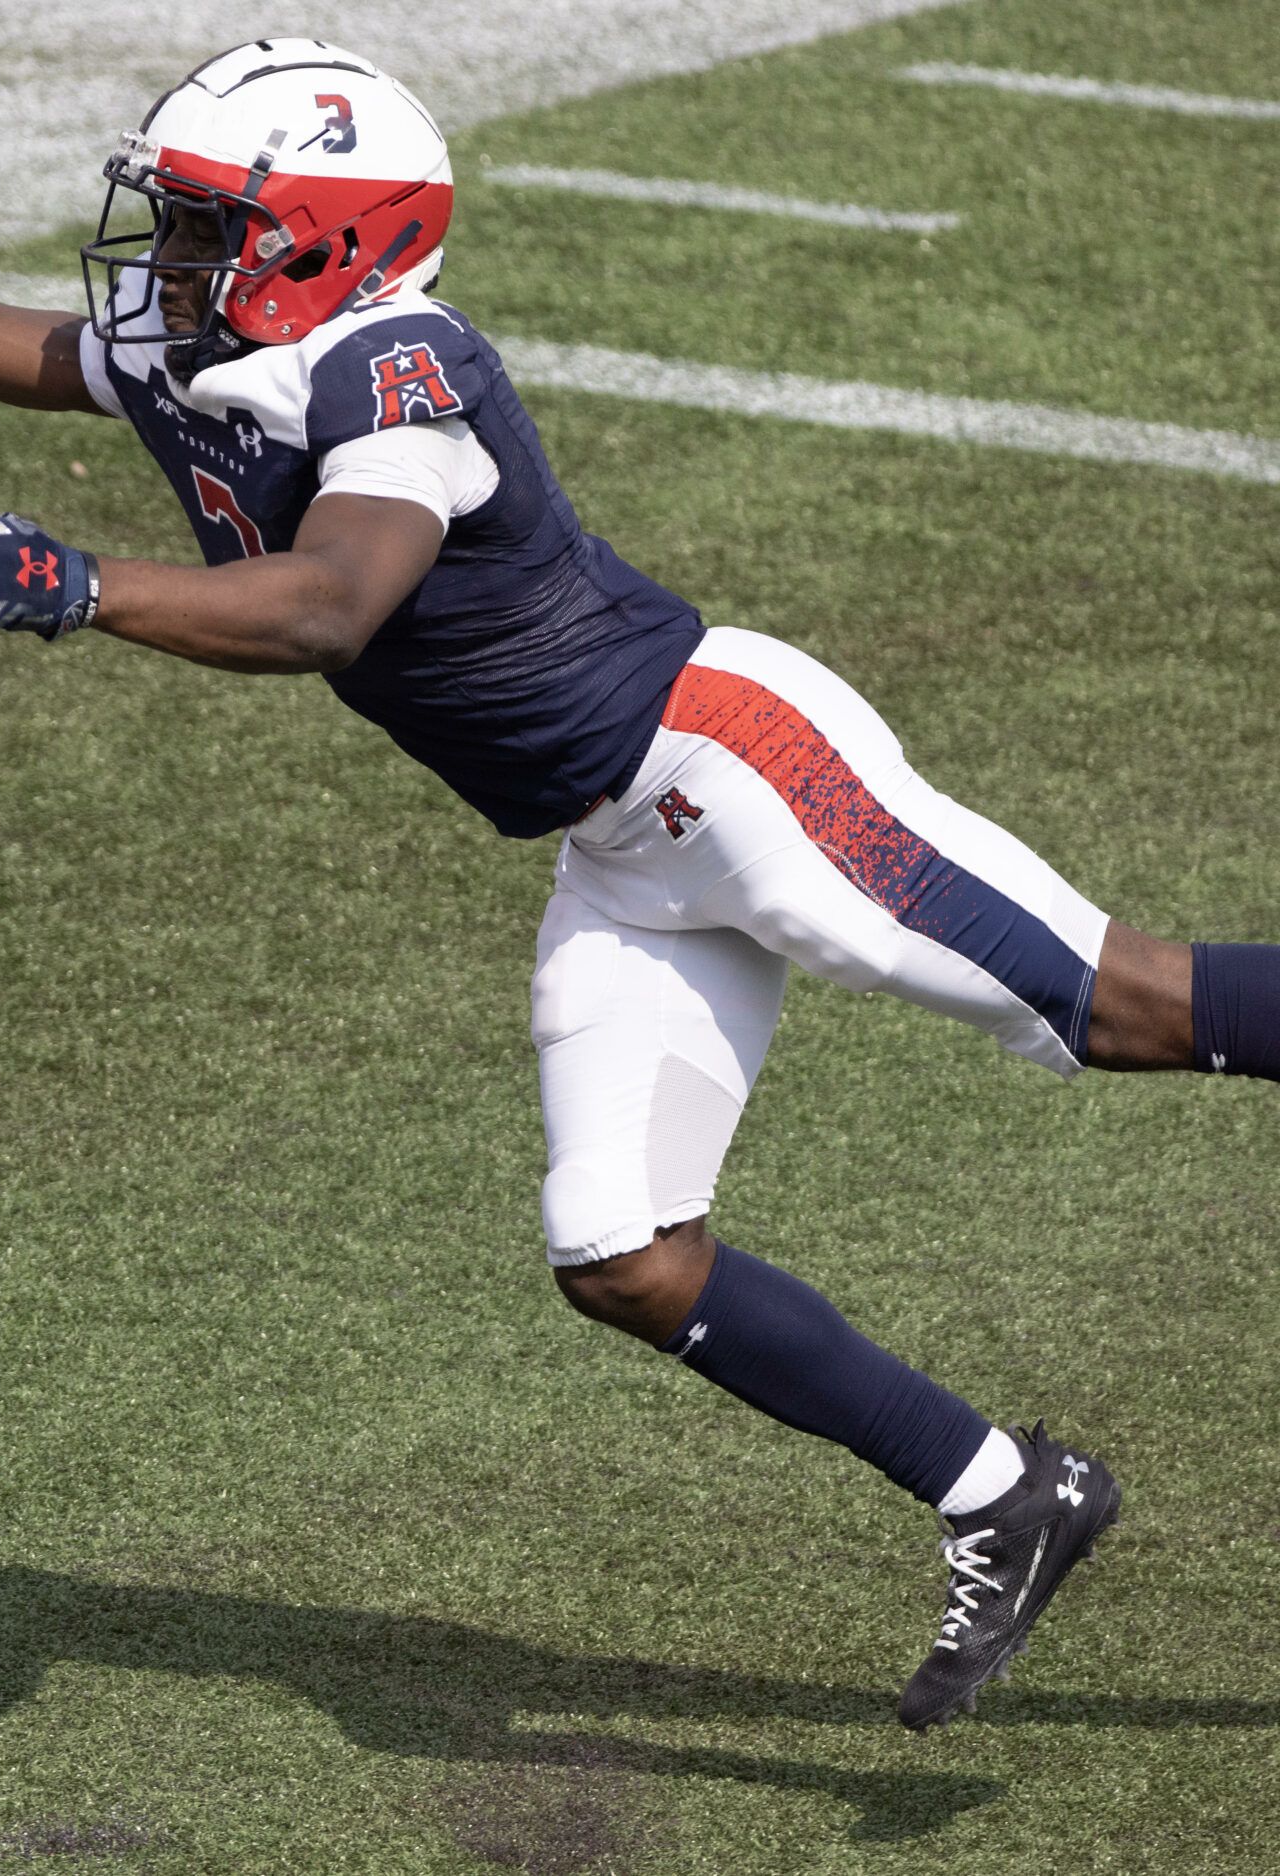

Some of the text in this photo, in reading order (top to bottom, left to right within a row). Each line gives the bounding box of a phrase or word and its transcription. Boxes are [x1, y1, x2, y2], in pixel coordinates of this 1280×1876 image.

[314, 94, 357, 154] 3
[153, 391, 188, 424] XFL
[178, 430, 245, 476] HOUSTON
